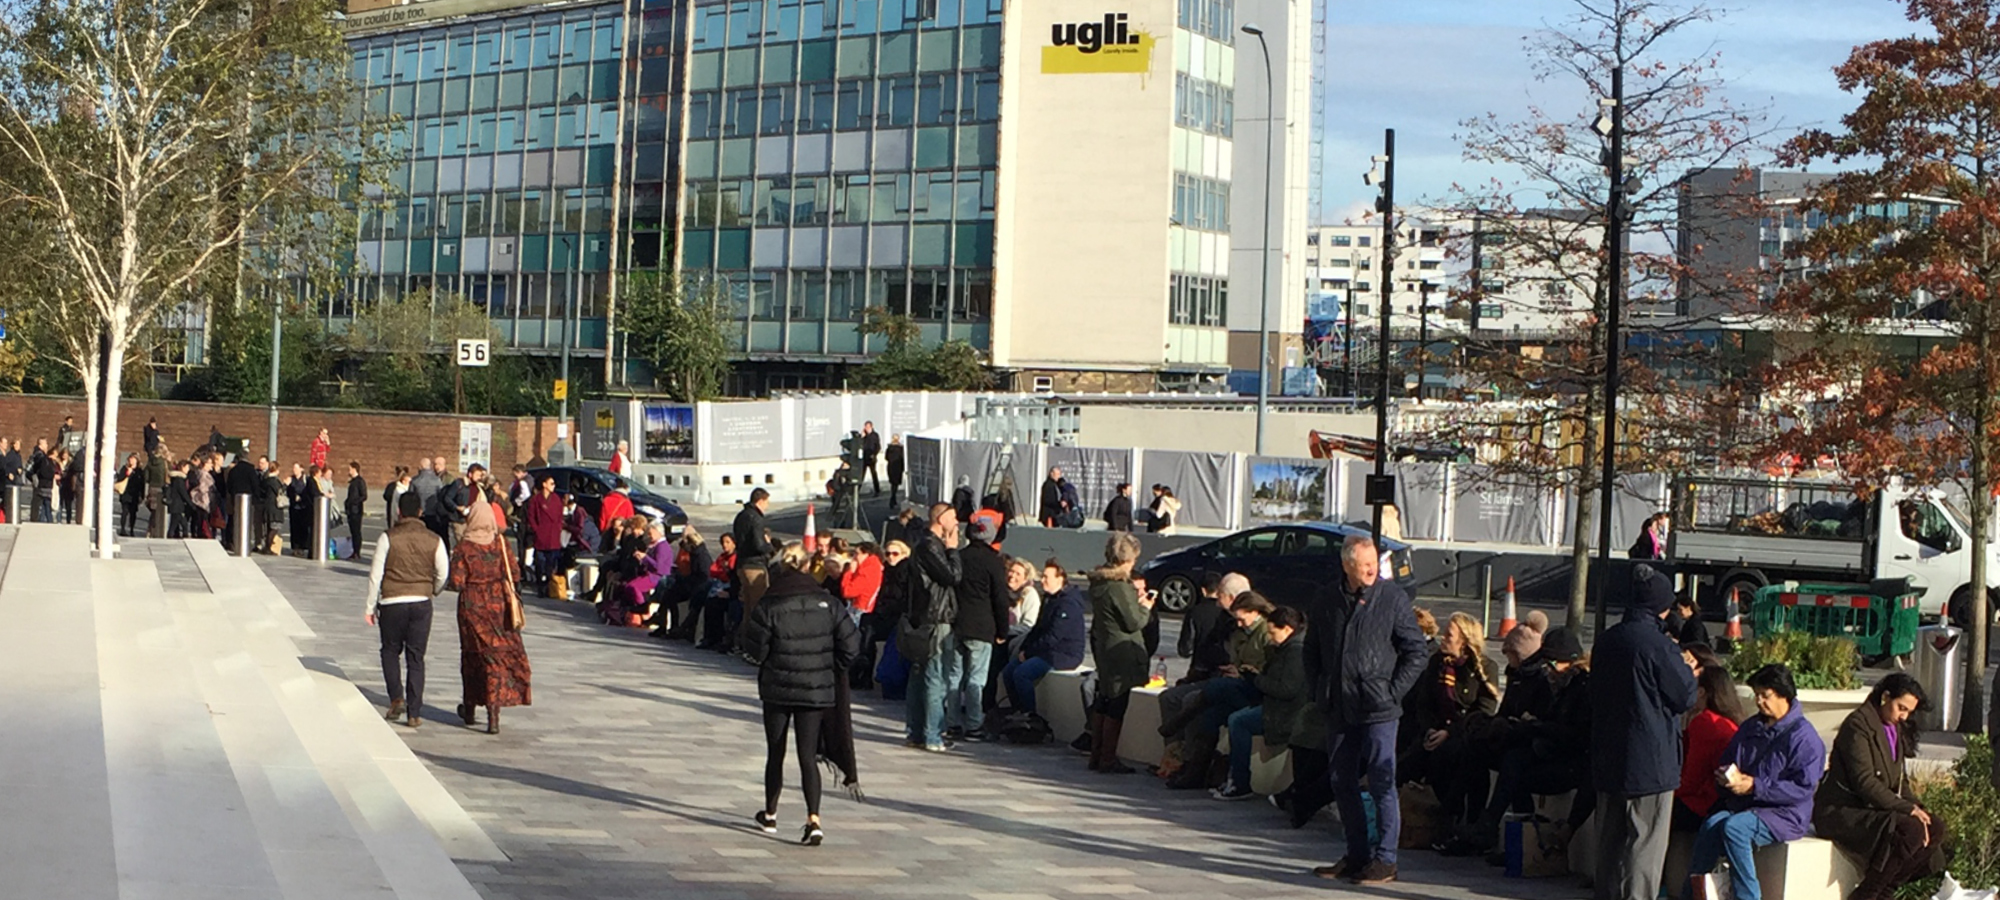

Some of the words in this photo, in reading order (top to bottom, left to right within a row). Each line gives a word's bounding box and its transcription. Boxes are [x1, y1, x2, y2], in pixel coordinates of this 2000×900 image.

[346, 15, 362, 28] You
[364, 11, 390, 25] could
[393, 9, 405, 21] be
[407, 8, 426, 19] too.
[1051, 13, 1139, 54] ugli.
